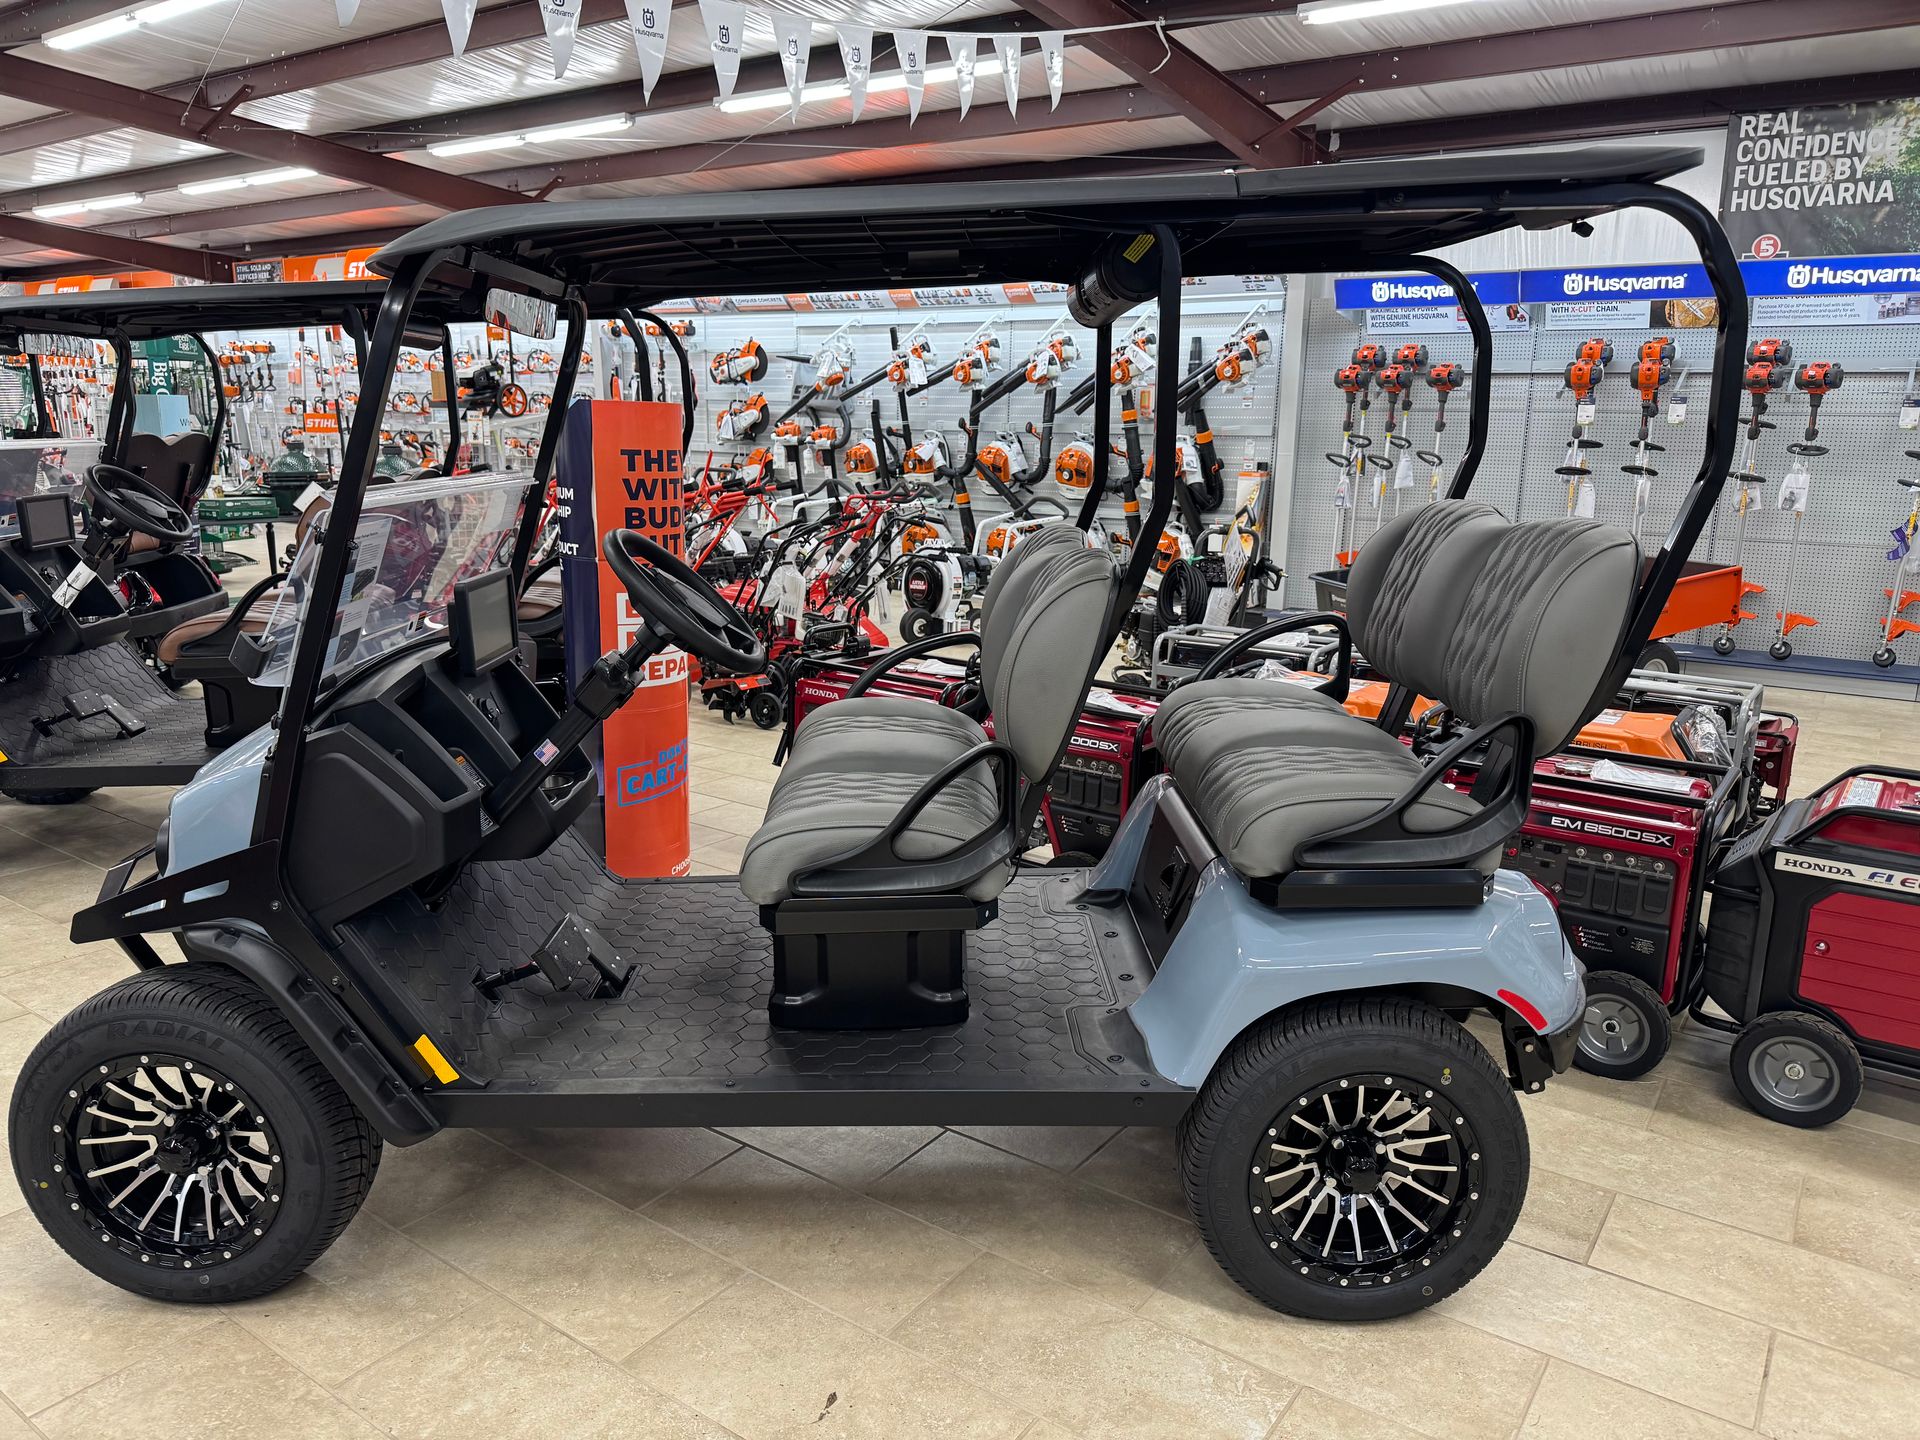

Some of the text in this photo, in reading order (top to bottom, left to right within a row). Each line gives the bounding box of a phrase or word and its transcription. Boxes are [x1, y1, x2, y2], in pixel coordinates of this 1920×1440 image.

[543, 4, 575, 19] Hsqvarna
[635, 27, 664, 40] Husqvarna
[1740, 111, 1803, 138] REAL
[1736, 127, 1901, 163] CONFIDENCE
[1733, 155, 1872, 187] FUELED BY
[1730, 179, 1895, 212] HUSQVARNA
[1584, 275, 1685, 294] Husqvarna
[1370, 314, 1385, 322] WITH
[1386, 313, 1411, 321] GENUINE
[151, 362, 168, 387] Big
[306, 418, 338, 428] STIHL
[804, 687, 839, 700] HONDA
[1783, 858, 1856, 877] HONDA
[1867, 872, 1895, 883] FI
[107, 1021, 226, 1056] RADIAL
